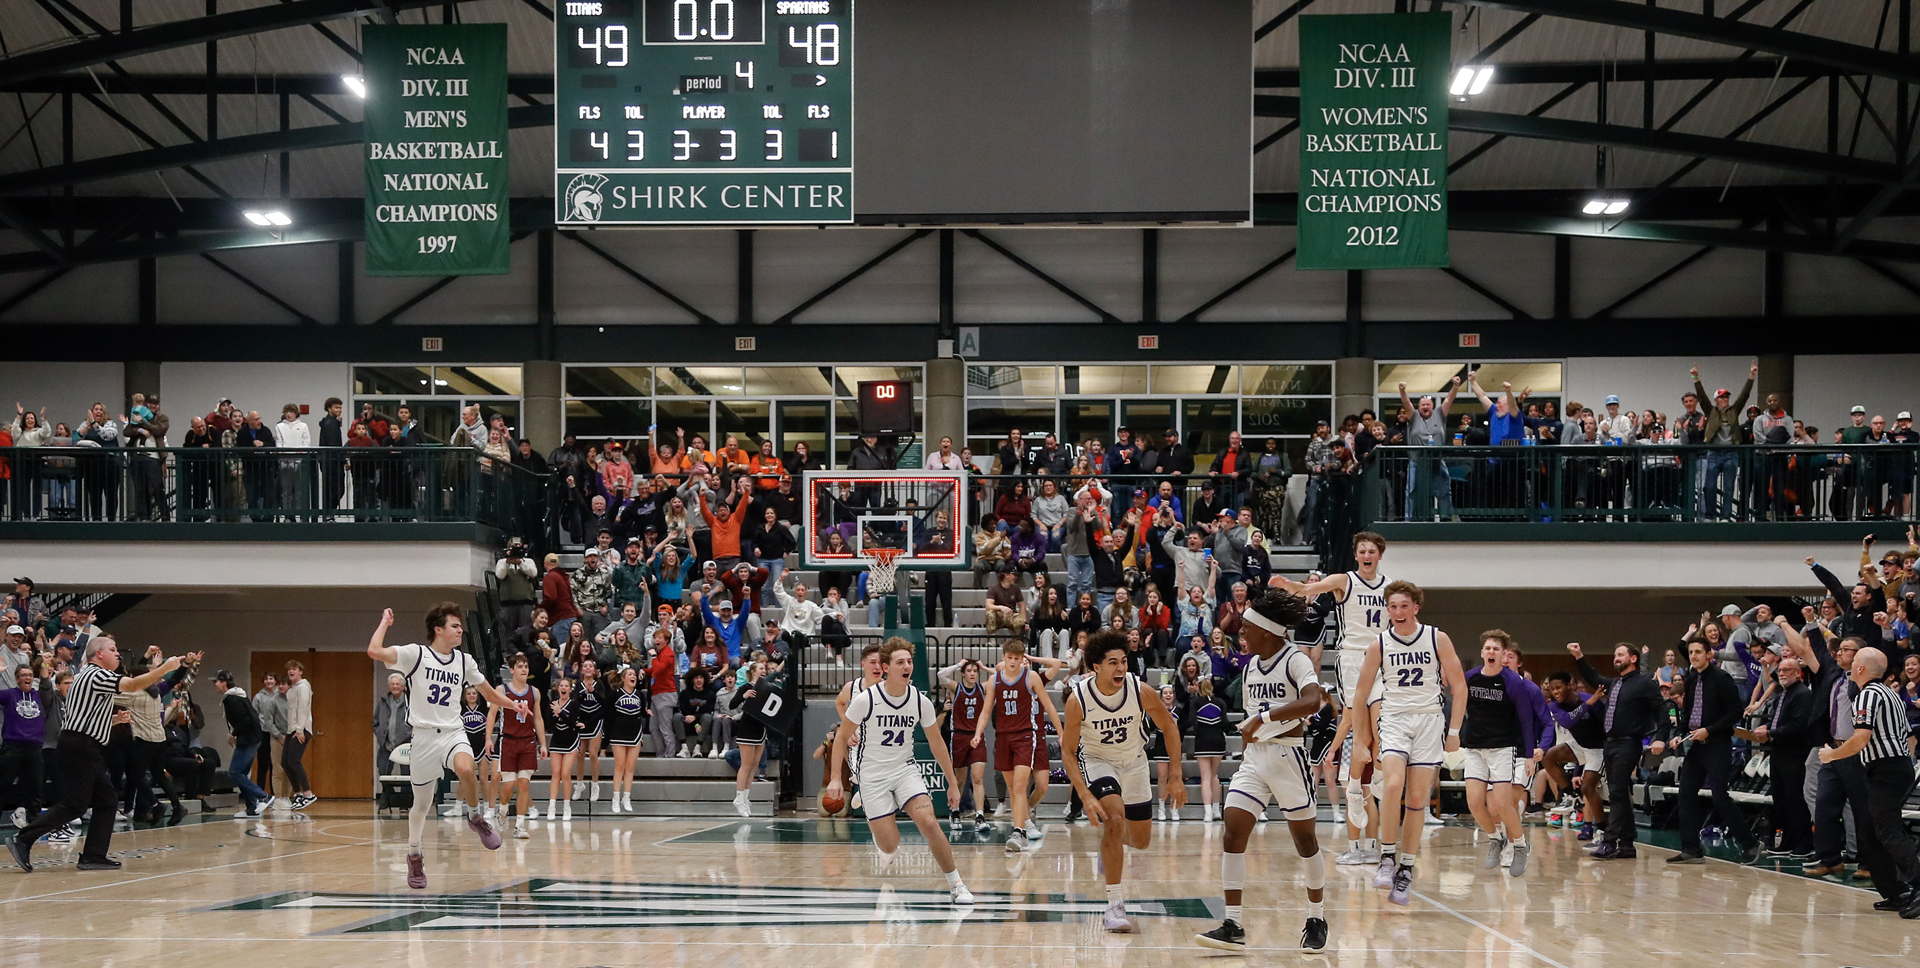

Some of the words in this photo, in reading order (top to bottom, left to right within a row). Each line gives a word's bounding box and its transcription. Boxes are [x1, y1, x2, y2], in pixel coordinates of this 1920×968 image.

[565, 1, 603, 16] TITANS
[776, 1, 830, 15] SPARTANS
[673, 0, 734, 40] 0.0
[578, 25, 629, 67] 49
[788, 23, 840, 65] 48
[1339, 43, 1411, 63] NCAA
[406, 47, 465, 66] NCAA
[686, 76, 722, 92] period
[735, 60, 754, 89] 4
[1334, 68, 1385, 89] DIV.
[1390, 67, 1416, 88] III
[401, 79, 441, 97] DIV.
[445, 78, 469, 97] III
[404, 110, 467, 128] MEN'S
[579, 106, 601, 119] FLS
[624, 106, 644, 119] TOL
[682, 105, 726, 119] PLAYER
[763, 105, 783, 119] TOL
[807, 104, 830, 119] FLS
[1321, 106, 1428, 126] WOMEN'S
[370, 141, 503, 160] BASKETBALL
[590, 131, 609, 159] 4
[627, 130, 645, 161] 3
[765, 129, 783, 161] 3
[831, 130, 838, 159] 1
[1306, 133, 1442, 152] BASKETBALL
[384, 173, 488, 191] NATIONAL
[1311, 168, 1435, 187] NATIONAL
[612, 185, 708, 209] SHIRK
[720, 184, 845, 209] CENTER
[1305, 194, 1442, 213] CHAMPIONS
[376, 204, 498, 223] CHAMPIONS
[418, 235, 457, 254] 1997
[1346, 226, 1399, 246] 2012
[425, 339, 440, 350] EXIT
[739, 338, 753, 349] EXIT
[962, 332, 977, 352] A
[1141, 336, 1156, 348] EXIT
[1463, 334, 1478, 346] EXIT
[1365, 608, 1381, 628] 14
[1388, 651, 1431, 667] TITANS
[425, 666, 459, 686] TITANS
[1397, 667, 1424, 687] 22
[427, 684, 452, 706] 32
[1002, 690, 1019, 699] SJO
[1248, 682, 1286, 698] TITANS
[1469, 685, 1504, 701] TITANS
[761, 692, 783, 717] D
[966, 706, 975, 719] 2
[1004, 700, 1018, 715] 11
[876, 715, 914, 728] TITANS
[880, 729, 905, 747] 24
[1100, 727, 1128, 745] 23
